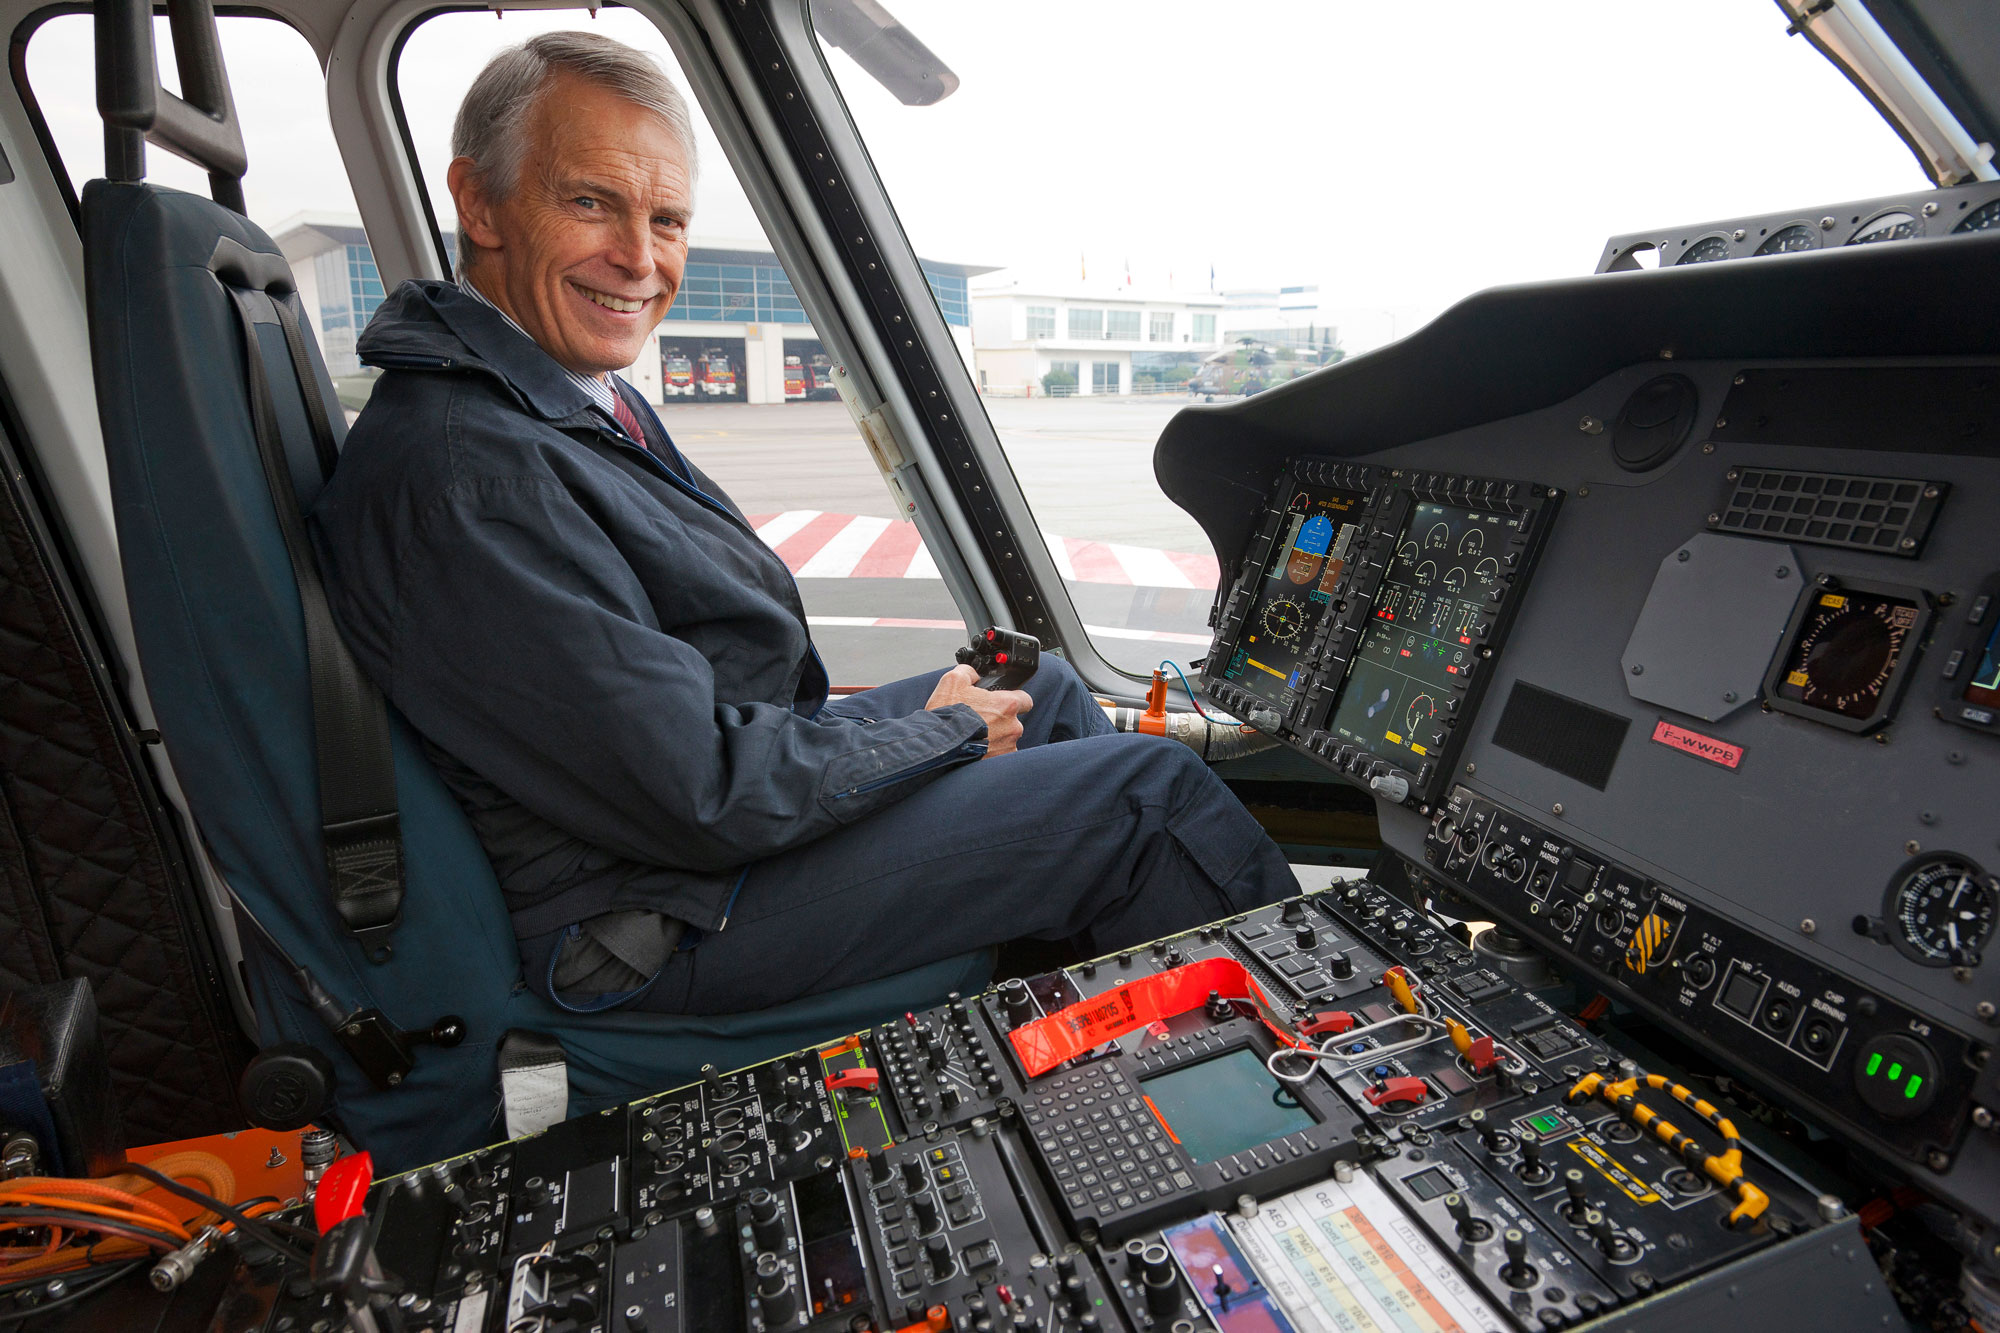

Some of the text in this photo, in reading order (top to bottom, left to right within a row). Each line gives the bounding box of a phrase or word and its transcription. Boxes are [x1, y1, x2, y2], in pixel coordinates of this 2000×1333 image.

[1663, 730, 1734, 761] F-WWPB
[1475, 812, 1485, 822] FMS
[1520, 835, 1531, 846] RA2
[1543, 841, 1560, 854] EVENT
[1539, 850, 1560, 865] MARKER
[1616, 883, 1630, 895] HYD
[1620, 897, 1637, 910] PUMP
[1660, 893, 1687, 912] TRAINING
[1400, 908, 1415, 920] FUEL
[1626, 912, 1639, 923] AUTO
[1917, 913, 1928, 925] 8
[1623, 926, 1633, 935] OFF
[1614, 938, 1627, 949] TEST
[1702, 941, 1717, 954] TEST
[1422, 984, 1435, 994] ENG
[1681, 986, 1697, 999] LAMP
[1777, 980, 1801, 998] AUDIO
[1523, 992, 1538, 1002] FIRE
[1679, 995, 1694, 1008] TEST
[1824, 990, 1845, 1005] CHIP
[1811, 998, 1848, 1023] BURNING
[1391, 1060, 1410, 1074] CRANK
[814, 1080, 832, 1123] COCKPIT LIGHTING
[1567, 1116, 1584, 1128] EPU
[755, 1123, 764, 1140] SAFETY
[767, 1140, 777, 1156] CABIN
[934, 1149, 944, 1160] OFF
[752, 1151, 761, 1165] EXITS
[941, 1168, 951, 1178] OFF
[1610, 1169, 1629, 1182] CUT
[1627, 1183, 1647, 1195] OFF
[1316, 1192, 1334, 1209] OEI
[1266, 1208, 1287, 1228] AEO
[1281, 1239, 1300, 1259] PMC
[1295, 1234, 1314, 1254] PMD
[1305, 1271, 1321, 1289] 770
[665, 1292, 675, 1307] ELT
